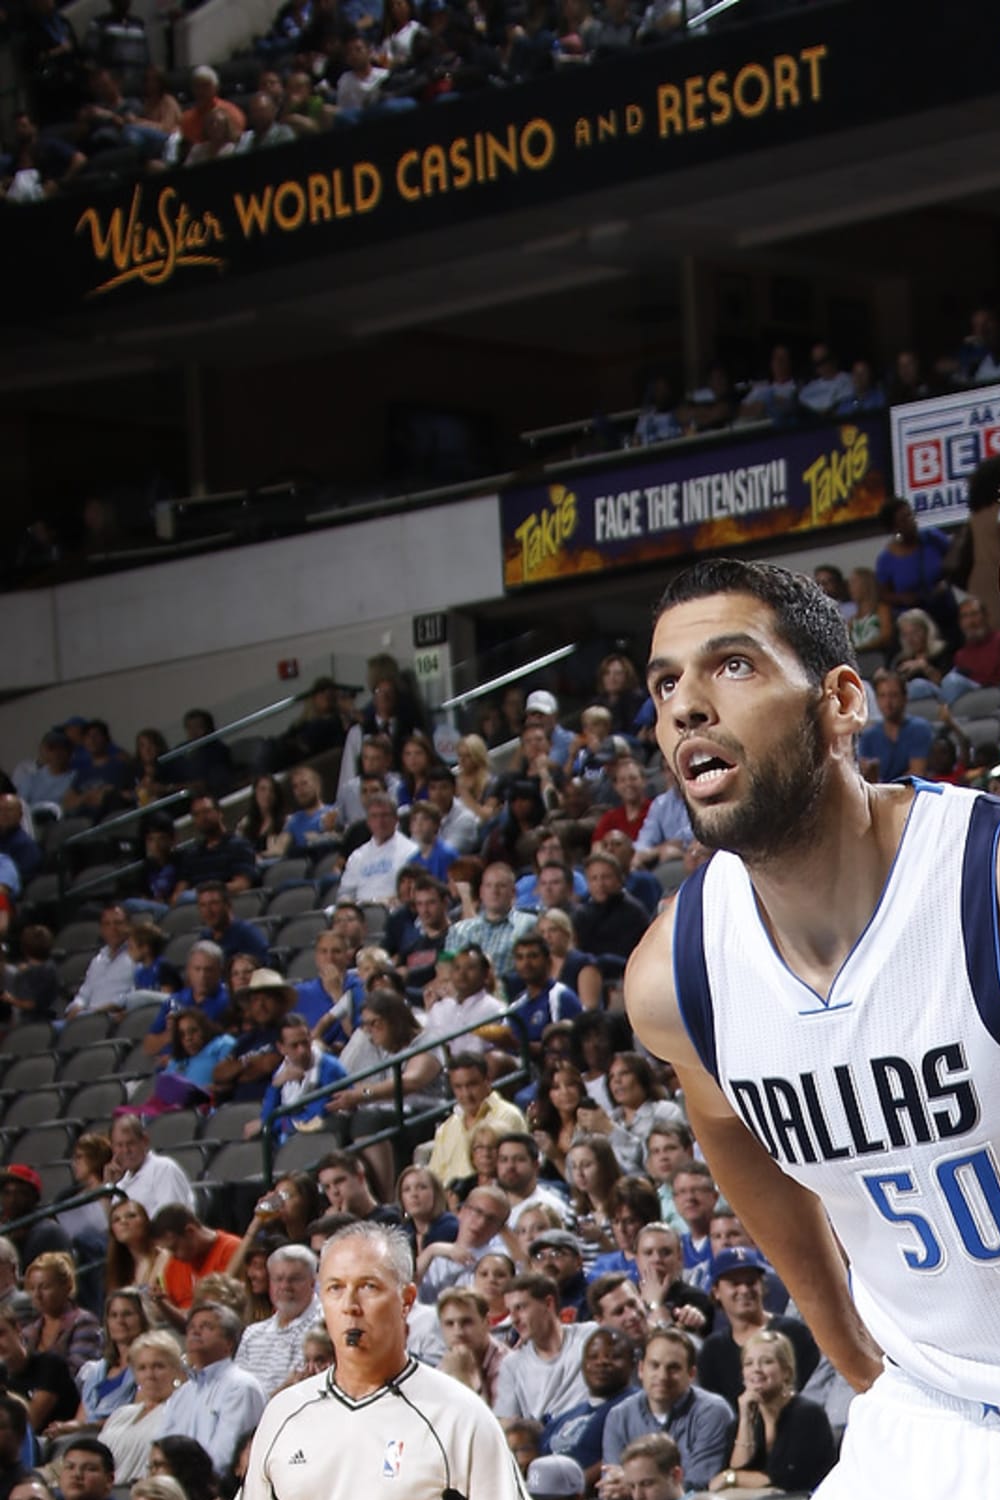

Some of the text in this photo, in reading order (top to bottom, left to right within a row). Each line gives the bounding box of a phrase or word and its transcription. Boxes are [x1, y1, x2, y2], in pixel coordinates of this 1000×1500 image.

[75, 44, 828, 288] WinStar WORLD CASINO AND RESORT
[968, 406, 994, 426] AA
[594, 490, 642, 542] FACE
[644, 481, 682, 532] THE
[802, 424, 869, 526] Takis
[914, 488, 969, 512] BAIL
[514, 484, 577, 583] Takis
[729, 1041, 983, 1167] DALLAS
